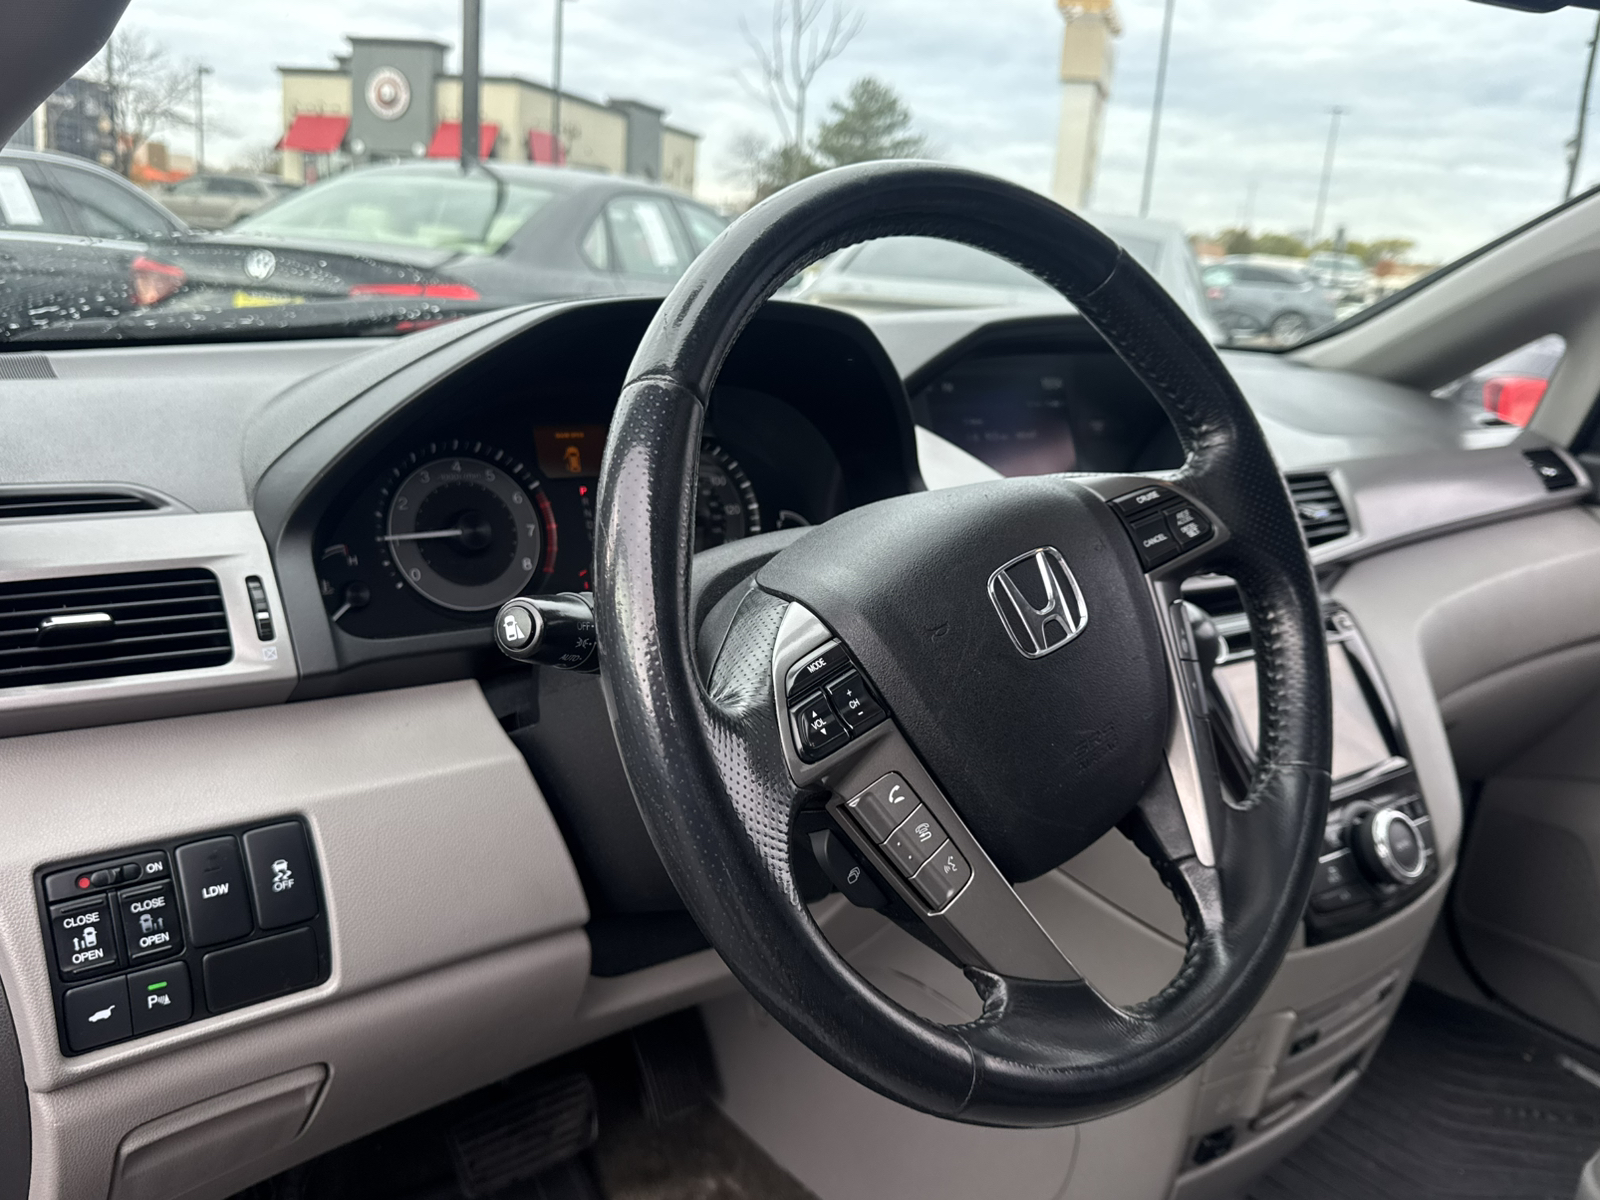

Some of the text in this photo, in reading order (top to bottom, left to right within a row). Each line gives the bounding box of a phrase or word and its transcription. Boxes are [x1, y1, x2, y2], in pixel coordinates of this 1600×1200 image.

[451, 460, 462, 473] 4
[420, 471, 430, 484] 3
[485, 469, 496, 482] 5
[579, 485, 588, 496] P
[512, 492, 523, 504] 6
[525, 525, 536, 538] 7
[521, 557, 533, 571] 8
[409, 567, 422, 582] 0
[577, 621, 591, 631] OFF
[806, 657, 827, 674] MODE
[848, 698, 861, 709] CH
[810, 718, 827, 730] VOL
[146, 861, 163, 874] ON
[202, 883, 229, 899] LDW
[272, 879, 295, 892] OFF
[130, 896, 166, 913] CLOSE
[63, 912, 100, 929] CLOSE
[139, 932, 170, 948] OPEN
[71, 948, 104, 964] OPEN
